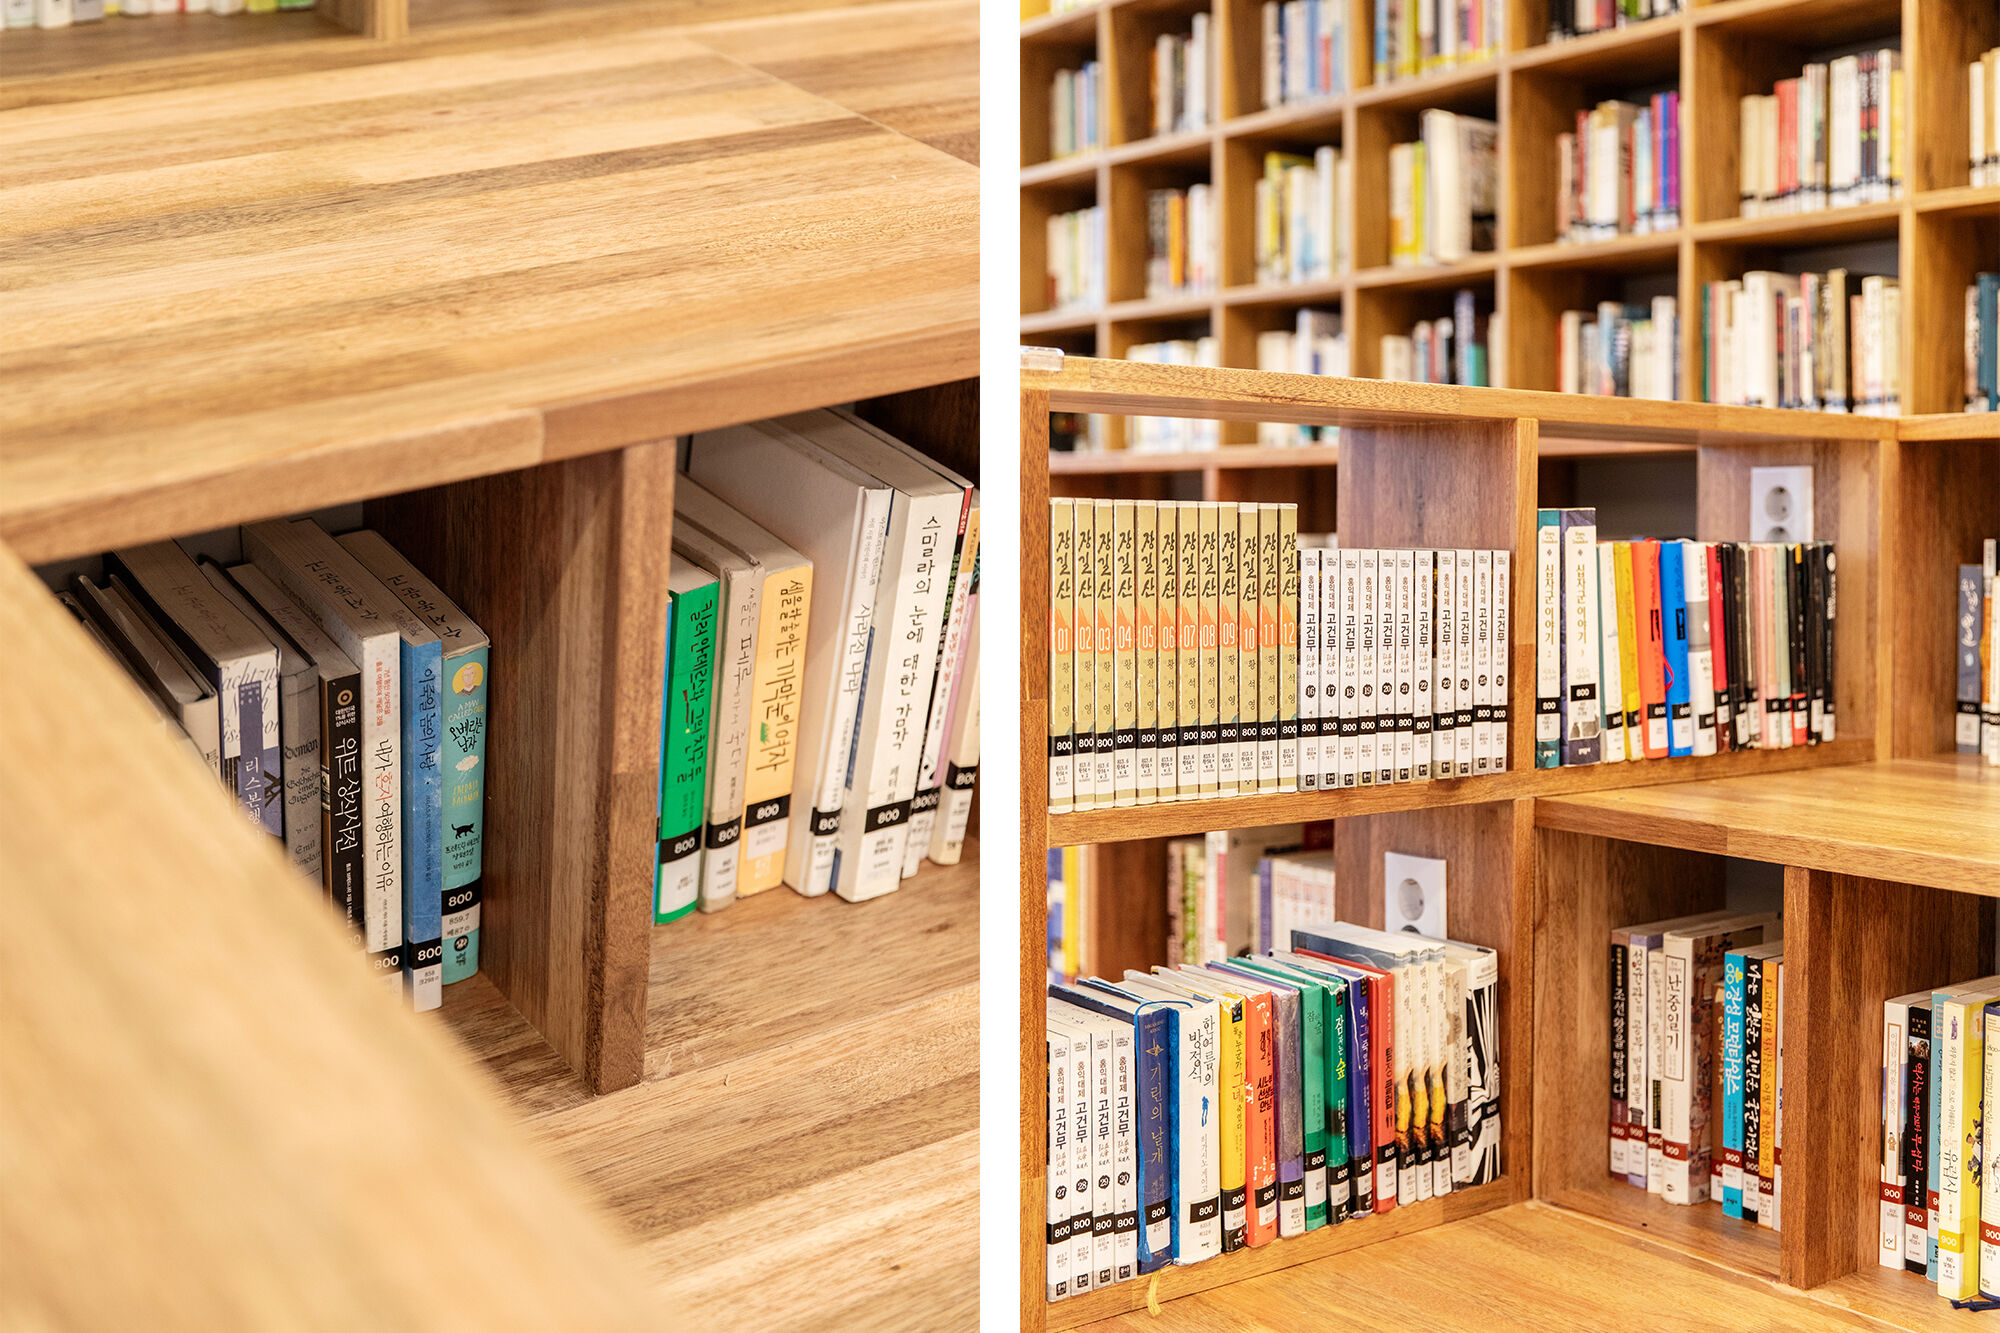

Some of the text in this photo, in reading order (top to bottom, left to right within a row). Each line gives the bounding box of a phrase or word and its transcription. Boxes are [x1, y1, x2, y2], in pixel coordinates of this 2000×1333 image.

[913, 515, 942, 595] 스밀라의
[1056, 529, 1071, 600] 장길산
[1078, 529, 1092, 599] 장길산
[1097, 531, 1111, 600] 장길산
[1117, 529, 1133, 599] 장길산
[1140, 529, 1155, 599] 장길산
[1162, 531, 1177, 599] 장길산
[1182, 531, 1196, 599] 장길산
[1202, 531, 1216, 599] 장길산
[1222, 530, 1236, 598] 장길산
[1262, 530, 1276, 599] 장길산
[1282, 531, 1296, 598] 장길산
[1242, 536, 1257, 602] 장길산
[781, 580, 804, 608] 셈을
[1545, 564, 1554, 645] 십자군 이야기
[1576, 564, 1586, 644] 십자군 이야기
[690, 600, 712, 637] 킬러
[849, 603, 871, 655] 사라진
[906, 605, 928, 644] 눈에
[1419, 611, 1429, 648] 고건무
[1442, 609, 1451, 646] 고건무
[1461, 611, 1469, 648] 고건무
[1479, 608, 1488, 643] 고건무
[1497, 608, 1505, 643] 고건무
[1058, 627, 1069, 651] 01
[1079, 626, 1092, 650] 02
[1098, 627, 1111, 651] 03
[1119, 625, 1132, 649] 04
[1142, 625, 1154, 648] 05
[1162, 624, 1175, 649] 06
[1183, 624, 1196, 648] 07
[1203, 624, 1216, 648] 08
[1223, 622, 1235, 645] 09
[1244, 627, 1255, 650] 10
[1264, 622, 1275, 646] 11
[1283, 622, 1295, 645] 12
[1306, 613, 1316, 652] 고건무
[1326, 613, 1337, 651] 고건무
[1345, 615, 1355, 653] 고건무
[1363, 614, 1373, 651] 고건무
[1383, 613, 1393, 651] 고건무
[1400, 613, 1410, 650] 고건무
[843, 661, 862, 695] 나라
[900, 653, 919, 696] 대한
[762, 659, 796, 728] 까막눈이
[1062, 662, 1070, 716] 황석영
[1084, 661, 1092, 715] 황석영
[1576, 688, 1590, 697] 800
[1478, 709, 1490, 718] 800
[1494, 710, 1506, 718] 800
[1542, 701, 1556, 710] 800
[450, 717, 483, 741] 오베라는
[691, 707, 705, 734] 그의
[892, 703, 912, 751] 감각
[1282, 725, 1297, 735] 800
[1301, 723, 1316, 731] 800
[1323, 722, 1337, 731] 800
[1342, 723, 1357, 731] 800
[1361, 721, 1375, 729] 800
[1380, 719, 1394, 727] 800
[1398, 718, 1412, 726] 800
[1416, 721, 1430, 729] 800
[1440, 717, 1453, 725] 800
[1458, 714, 1471, 722] 800
[1078, 738, 1094, 748] 800
[1097, 738, 1113, 748] 800
[1117, 733, 1133, 744] 800
[1141, 733, 1156, 743] 800
[1162, 732, 1177, 743] 800
[1183, 730, 1198, 741] 800
[1201, 730, 1217, 740] 800
[1222, 728, 1237, 738] 800
[1242, 727, 1257, 737] 800
[1261, 726, 1277, 736] 800
[374, 738, 393, 772] 내가
[457, 735, 477, 752] 남자
[685, 735, 706, 762] 친구
[726, 729, 746, 768] 죽다
[756, 729, 792, 771] 여자
[1057, 740, 1073, 751] 800
[334, 737, 357, 778] 위트
[419, 743, 436, 771] 사랑
[374, 770, 393, 803] 혼자
[677, 766, 701, 783] 둘
[334, 778, 362, 853] 상식사전
[756, 803, 779, 819] 800
[877, 808, 900, 825] 800
[374, 801, 394, 862] 여행하는
[718, 825, 739, 842] 800
[674, 837, 695, 854] 800
[374, 861, 394, 892] 이유
[448, 891, 473, 907] 800
[449, 913, 470, 926] 859.7
[374, 954, 399, 971] 800
[418, 946, 442, 961] 800
[1667, 974, 1681, 1050] 난중일기
[1203, 1015, 1216, 1087] 한여름의
[1724, 986, 1742, 1096] 경성 모던타임스
[1188, 1028, 1202, 1083] 방정식
[1076, 1102, 1088, 1144] 고건무
[1098, 1099, 1110, 1140] 고건무
[1117, 1096, 1130, 1137] 고건무
[1150, 1063, 1164, 1164] 기린의 날개
[1911, 1062, 1925, 1172] 역사는 무섭다
[1055, 1108, 1066, 1150] 고건무
[1311, 1155, 1324, 1165] 800
[1385, 1147, 1395, 1157] 800
[1666, 1146, 1679, 1156] 900
[1725, 1152, 1739, 1163] 900
[1337, 1168, 1348, 1179] 800
[1361, 1160, 1371, 1171] 800
[1746, 1161, 1759, 1172] 900
[1232, 1195, 1245, 1205] 800
[1264, 1189, 1275, 1200] 800
[1289, 1185, 1303, 1195] 800
[1884, 1188, 1900, 1199] 900
[1117, 1216, 1134, 1227] 800
[1151, 1207, 1165, 1219] 800
[1199, 1205, 1213, 1216] 800
[1908, 1211, 1923, 1223] 900
[1055, 1225, 1070, 1237] 800
[1074, 1218, 1090, 1229] 800
[1095, 1219, 1112, 1230] 800
[1985, 1229, 2000, 1241] 900
[1941, 1235, 1956, 1247] 900
